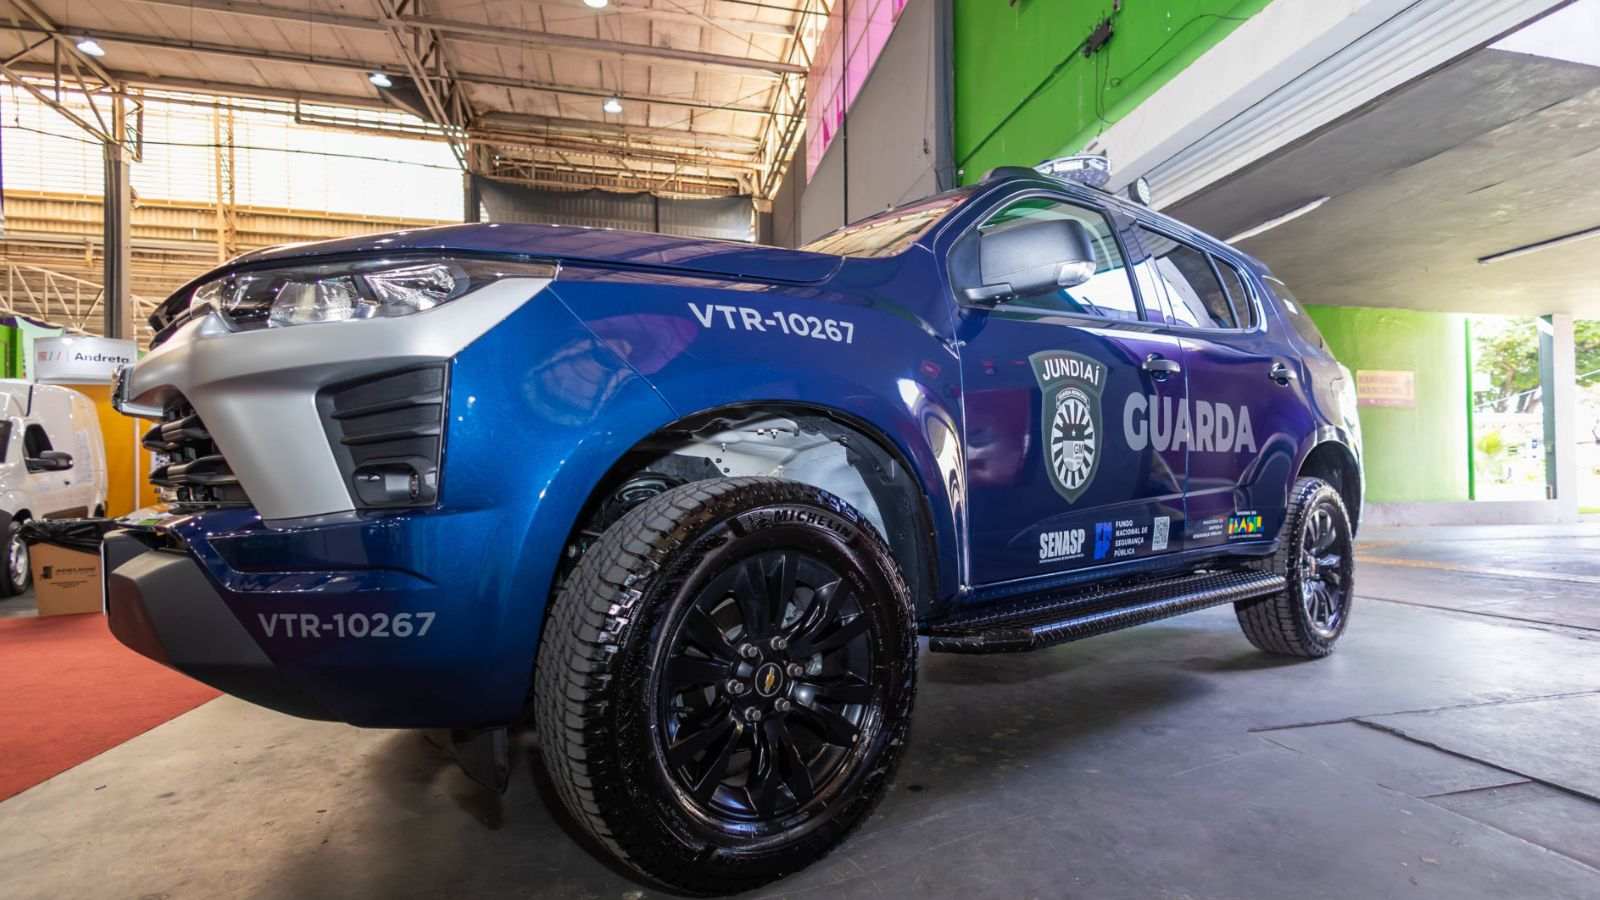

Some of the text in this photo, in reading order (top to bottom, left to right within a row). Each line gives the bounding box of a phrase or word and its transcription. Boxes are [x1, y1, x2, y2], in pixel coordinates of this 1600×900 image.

[687, 302, 854, 344] VTR-10267
[75, 352, 129, 364] Andreta
[1043, 358, 1100, 386] JUNDIAÍ
[1123, 391, 1257, 453] GUARDA
[774, 509, 853, 538] MICHELIN
[1115, 519, 1133, 528] FUNDO
[1115, 526, 1148, 537] NACIONAL DE
[1039, 529, 1086, 559] SENASP
[1115, 536, 1144, 546] SEGURANÇA
[257, 611, 436, 638] VTR-10267
